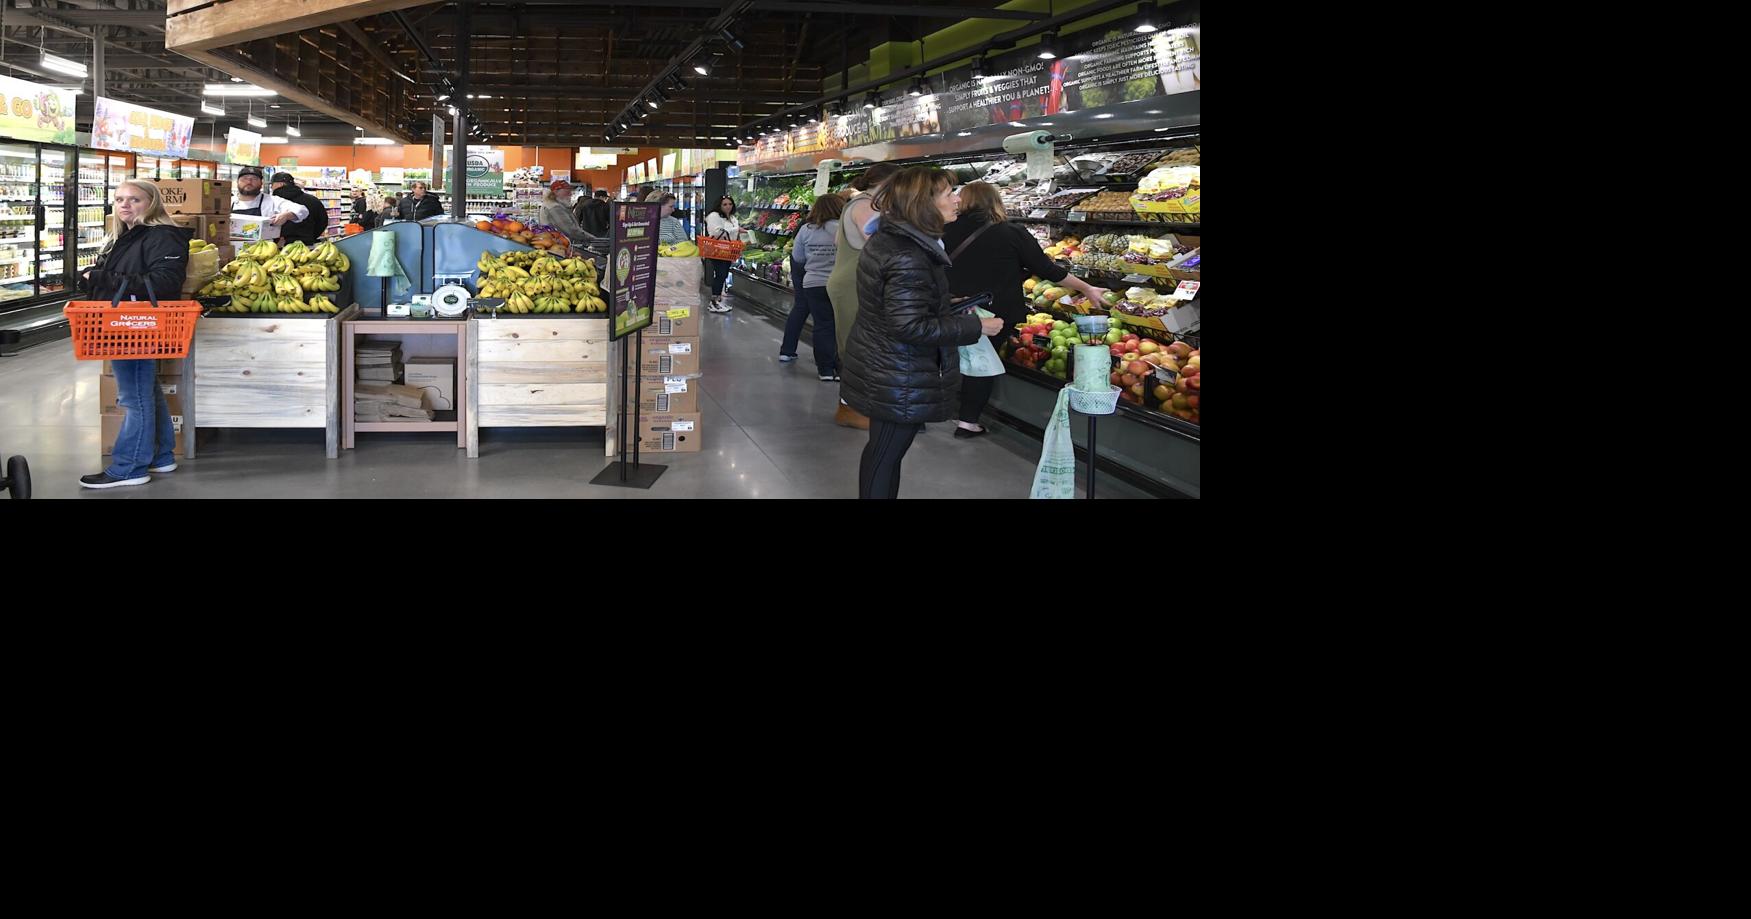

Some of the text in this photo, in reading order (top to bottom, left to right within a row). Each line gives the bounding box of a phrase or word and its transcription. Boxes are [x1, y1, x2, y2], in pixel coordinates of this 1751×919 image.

[1084, 61, 1103, 69] ORGANIC
[1124, 49, 1149, 61] SUPPORTS
[1078, 69, 1096, 78] ORGANIC
[1129, 73, 1143, 81] MORE
[1130, 66, 1144, 74] FARM
[950, 80, 971, 93] ORGANIC
[971, 80, 976, 88] IS
[1008, 62, 1044, 77] NON-GMO!
[955, 91, 971, 102] SIMPLY
[994, 80, 1020, 93] VEGGIES
[1020, 76, 1038, 87] THAT
[973, 96, 1002, 108] HEALTHIER
[1002, 92, 1016, 102] YOU
[1016, 91, 1021, 99] &
[1022, 85, 1050, 99] PLANET!
[12, 97, 33, 118] GO
[159, 187, 183, 196] OKE
[162, 196, 183, 204] ARM
